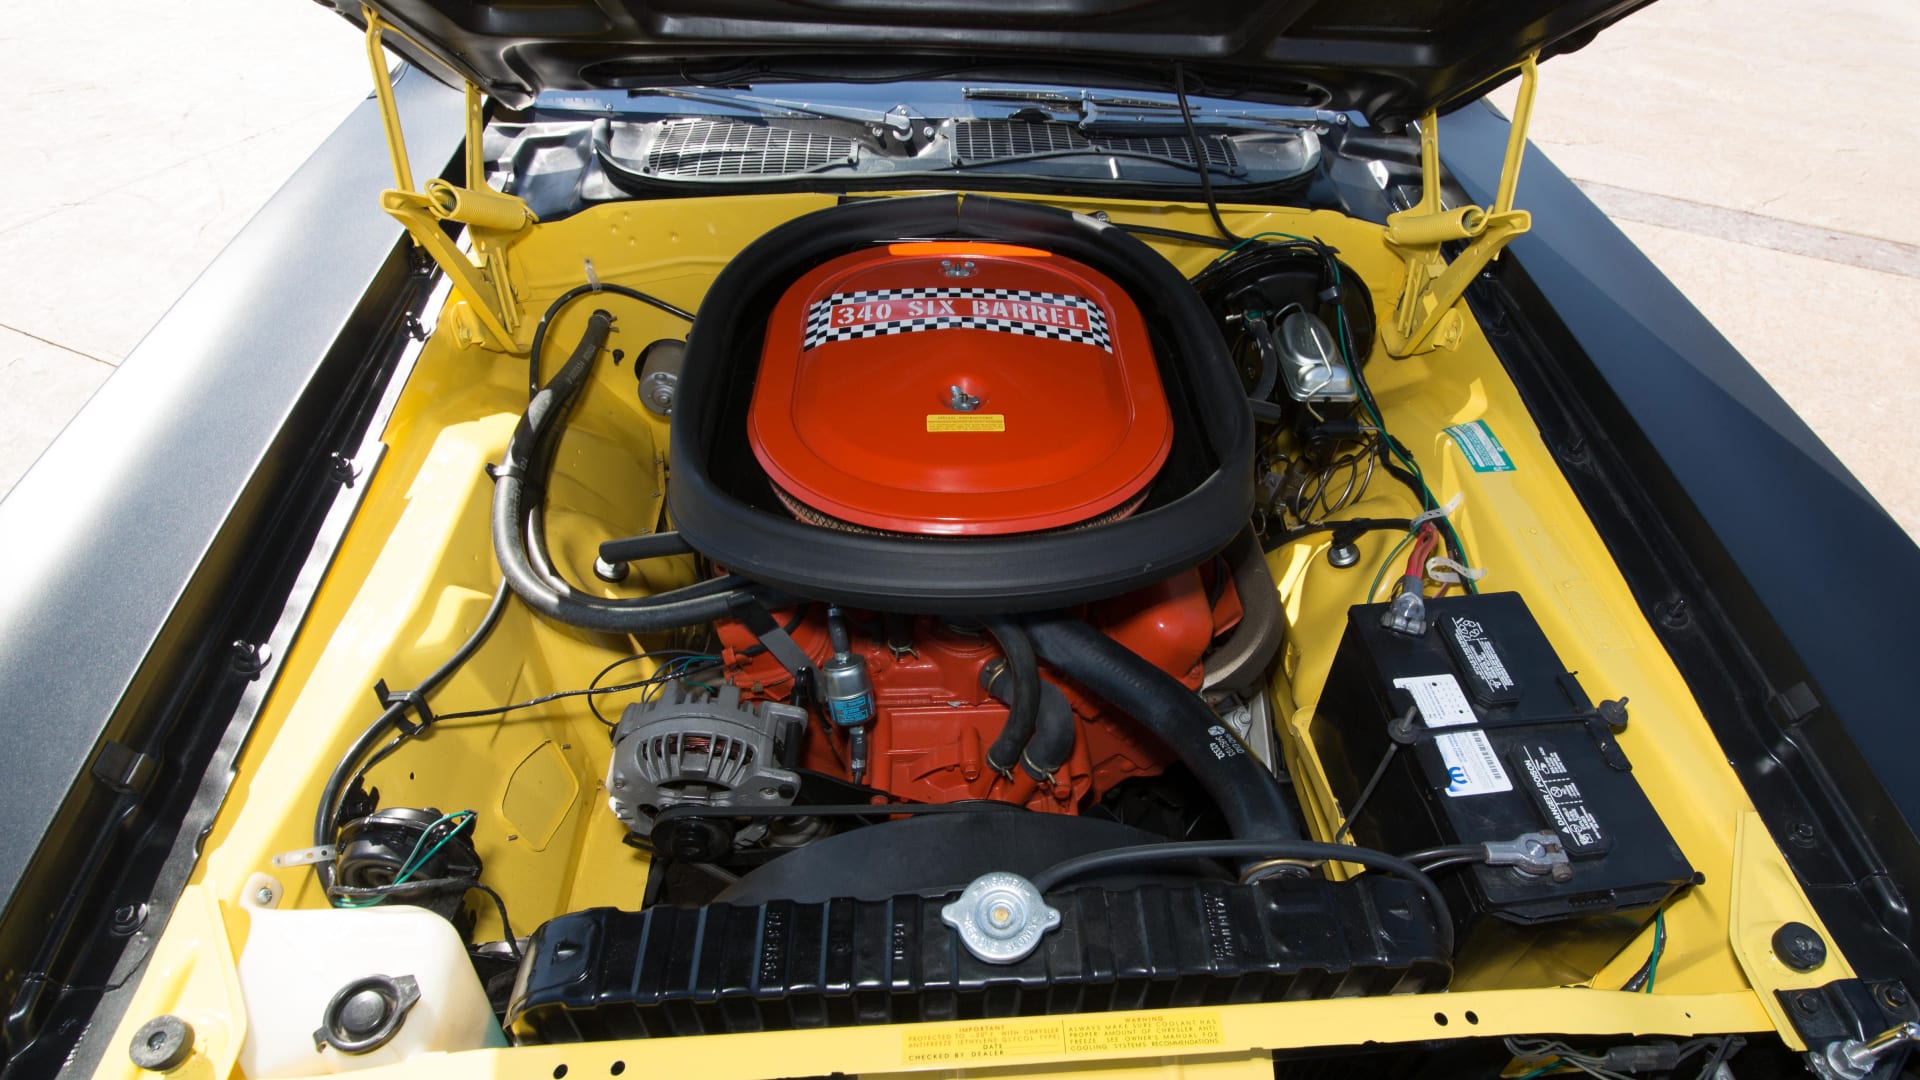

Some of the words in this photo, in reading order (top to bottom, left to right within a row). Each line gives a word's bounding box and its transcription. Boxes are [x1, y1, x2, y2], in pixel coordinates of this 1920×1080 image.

[837, 303, 891, 325] 340
[908, 300, 955, 316] SIX
[972, 300, 1083, 328] BARREL
[1210, 742, 1225, 760] 42332
[1524, 760, 1544, 788] POISON
[1543, 794, 1565, 826] DANGER
[959, 1024, 1005, 1032] IMPORTANT
[1024, 1027, 1060, 1035] CHRYSLER
[908, 1040, 951, 1048] ANTIFREEZE
[908, 1052, 950, 1062] CHECKED
